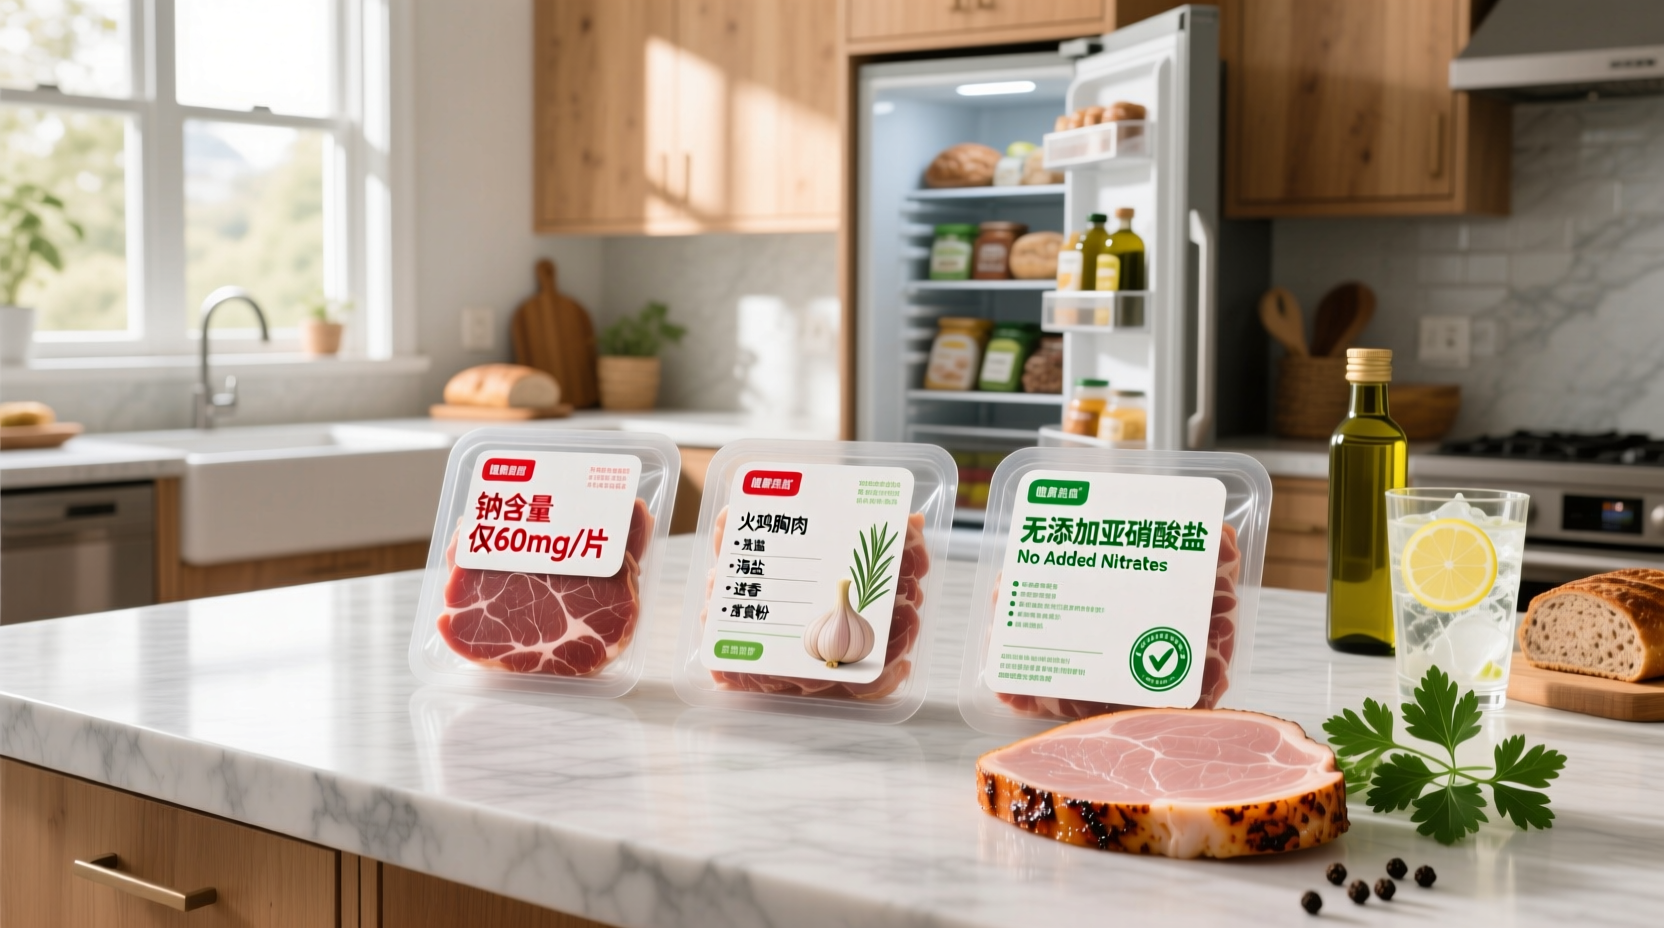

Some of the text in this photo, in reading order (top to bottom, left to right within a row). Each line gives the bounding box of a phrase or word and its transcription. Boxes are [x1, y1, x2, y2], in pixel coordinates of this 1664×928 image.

[475, 491, 554, 523] 钠含量
[737, 511, 809, 536] 火鸡胸肉
[1020, 516, 1209, 552] 无添加亚硝酸盐
[468, 523, 609, 562] 仅60mg/片
[1016, 548, 1168, 572] No Added Nitrates
